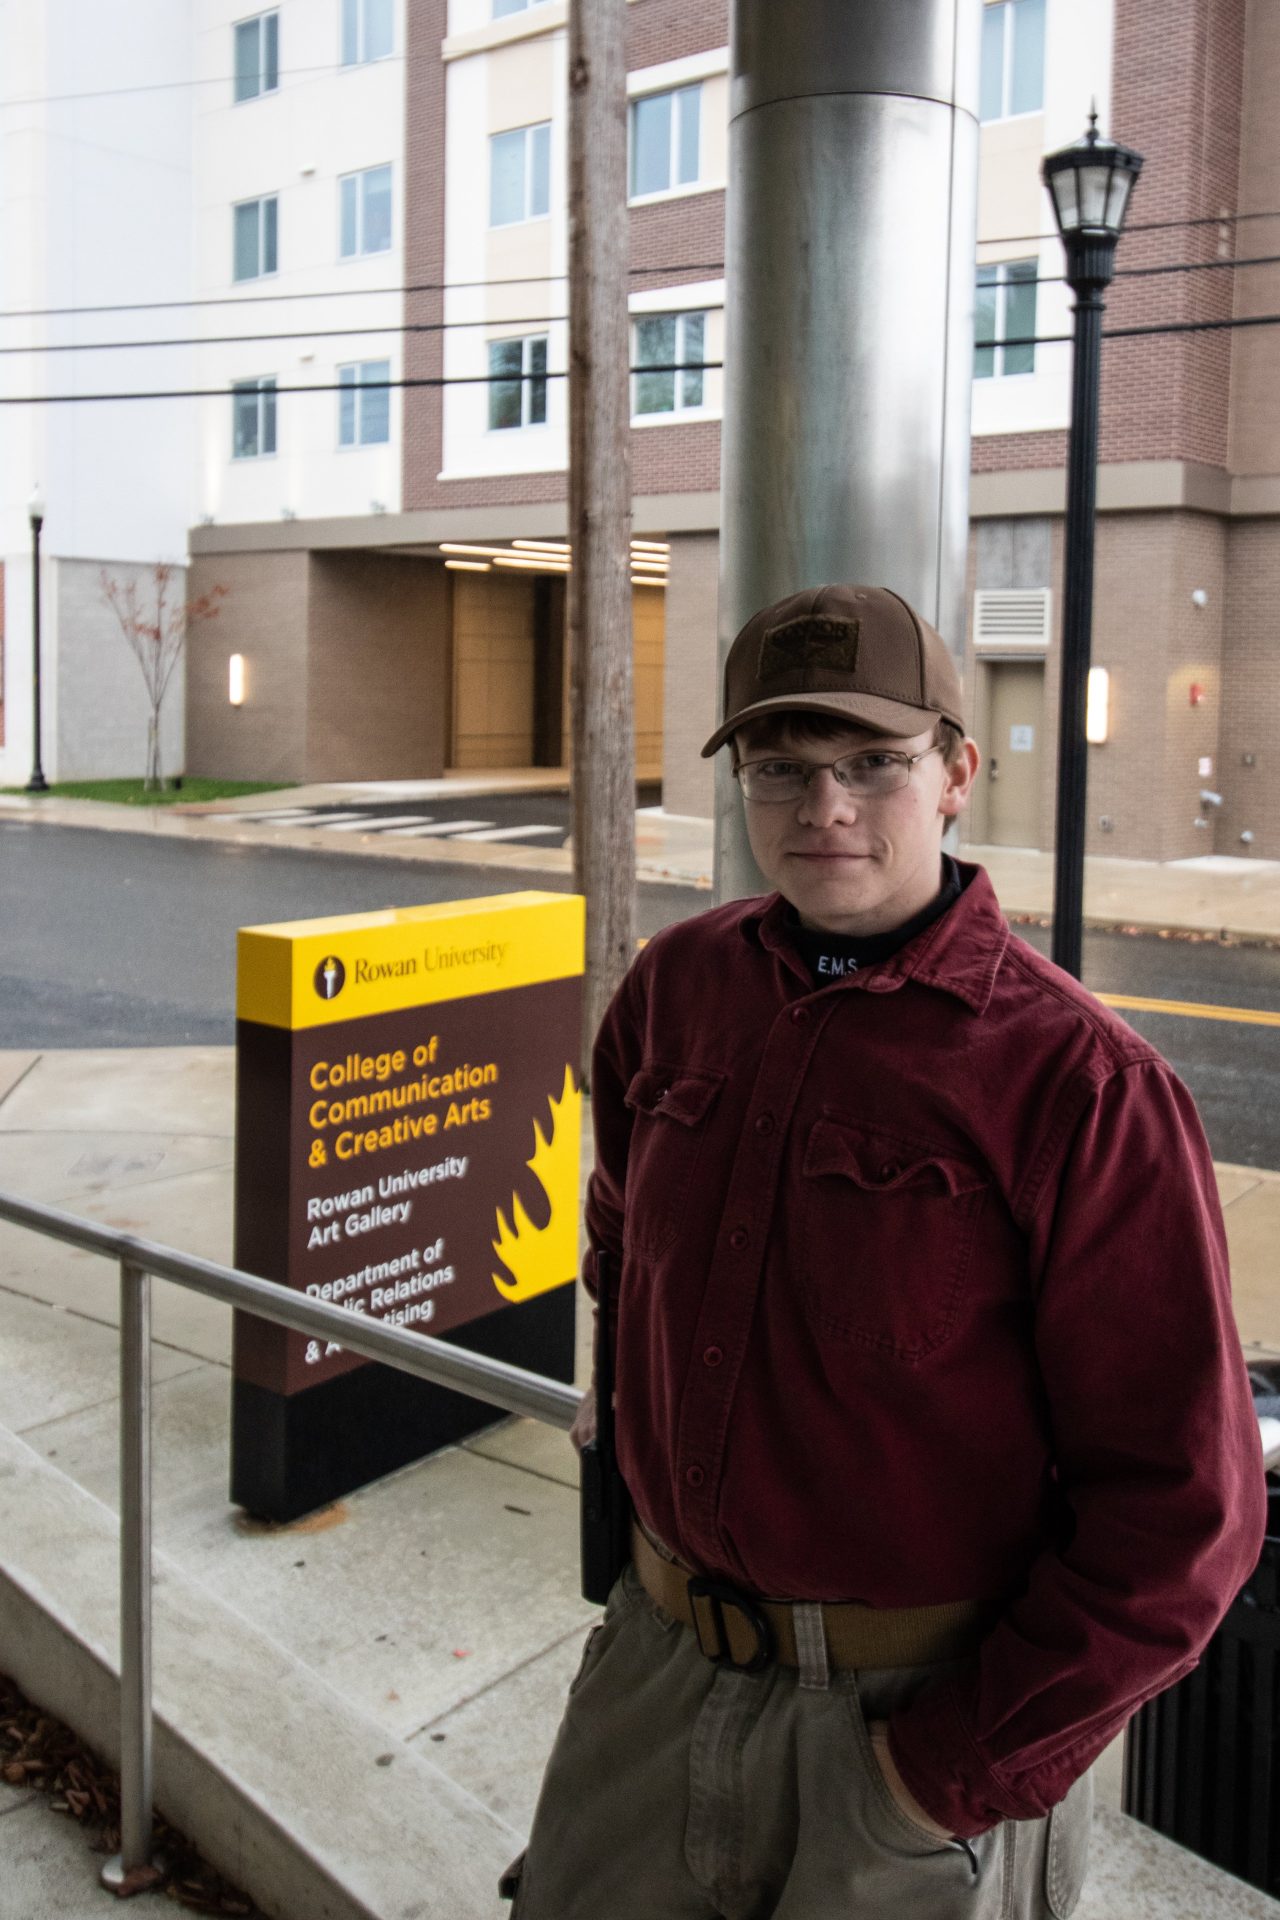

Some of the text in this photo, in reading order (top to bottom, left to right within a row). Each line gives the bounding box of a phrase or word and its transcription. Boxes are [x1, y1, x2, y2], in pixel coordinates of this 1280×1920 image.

[354, 941, 507, 984] Rowan University
[309, 1035, 439, 1091] College of
[308, 1063, 498, 1129] Communication
[308, 1097, 492, 1168] & Creative Arts
[306, 1156, 468, 1221] Rowan University
[306, 1200, 413, 1249] Art Gallery
[305, 1237, 445, 1301] Department of
[370, 1266, 456, 1310] Relations
[304, 1340, 321, 1364] &
